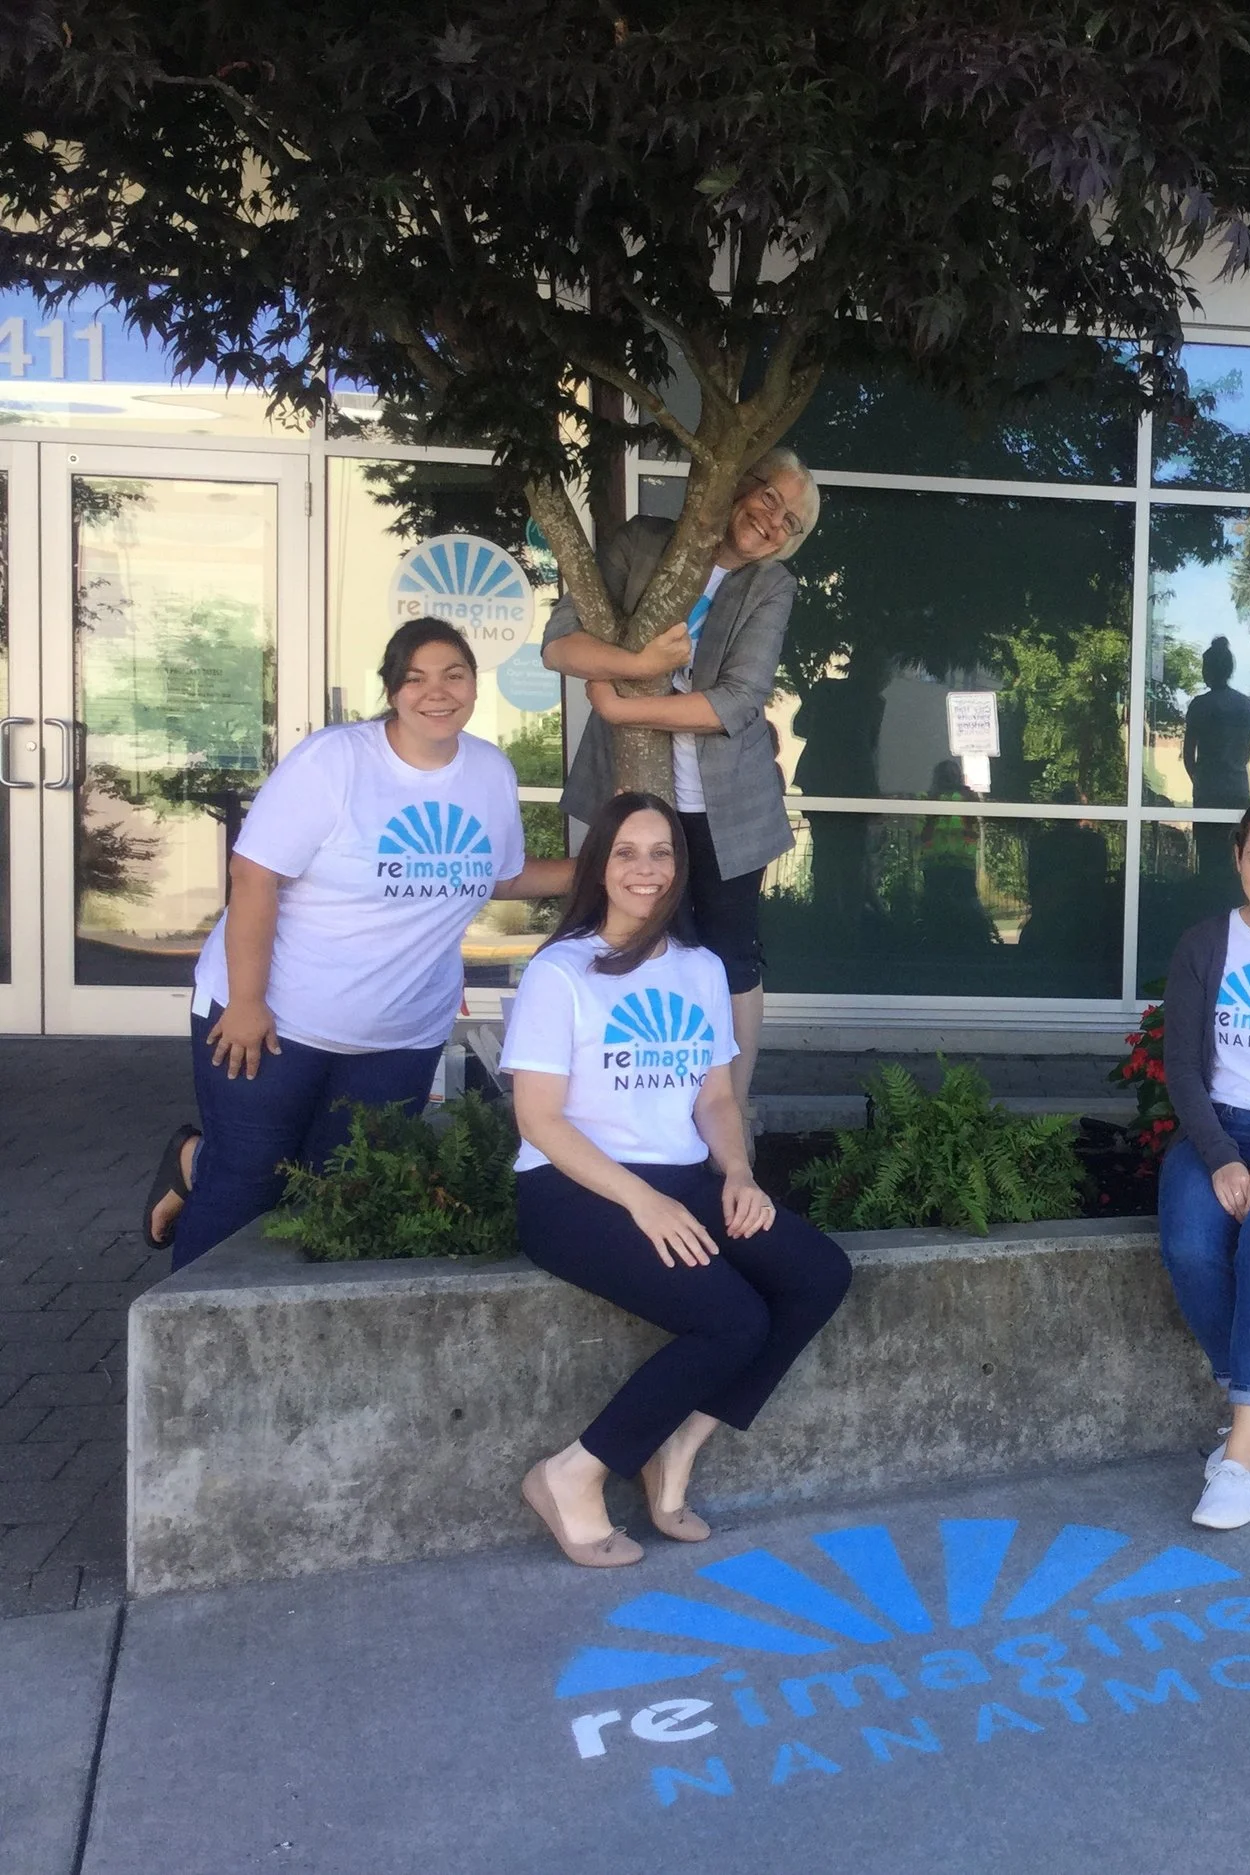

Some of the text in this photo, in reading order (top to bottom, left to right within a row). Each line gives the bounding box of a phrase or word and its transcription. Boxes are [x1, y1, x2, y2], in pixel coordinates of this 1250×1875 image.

[0, 316, 104, 382] 411
[396, 594, 524, 628] reimagine
[460, 624, 516, 641] AIMO
[377, 855, 493, 888] reimagine
[384, 884, 488, 898] NANAIMO
[603, 1042, 713, 1077] reimagin
